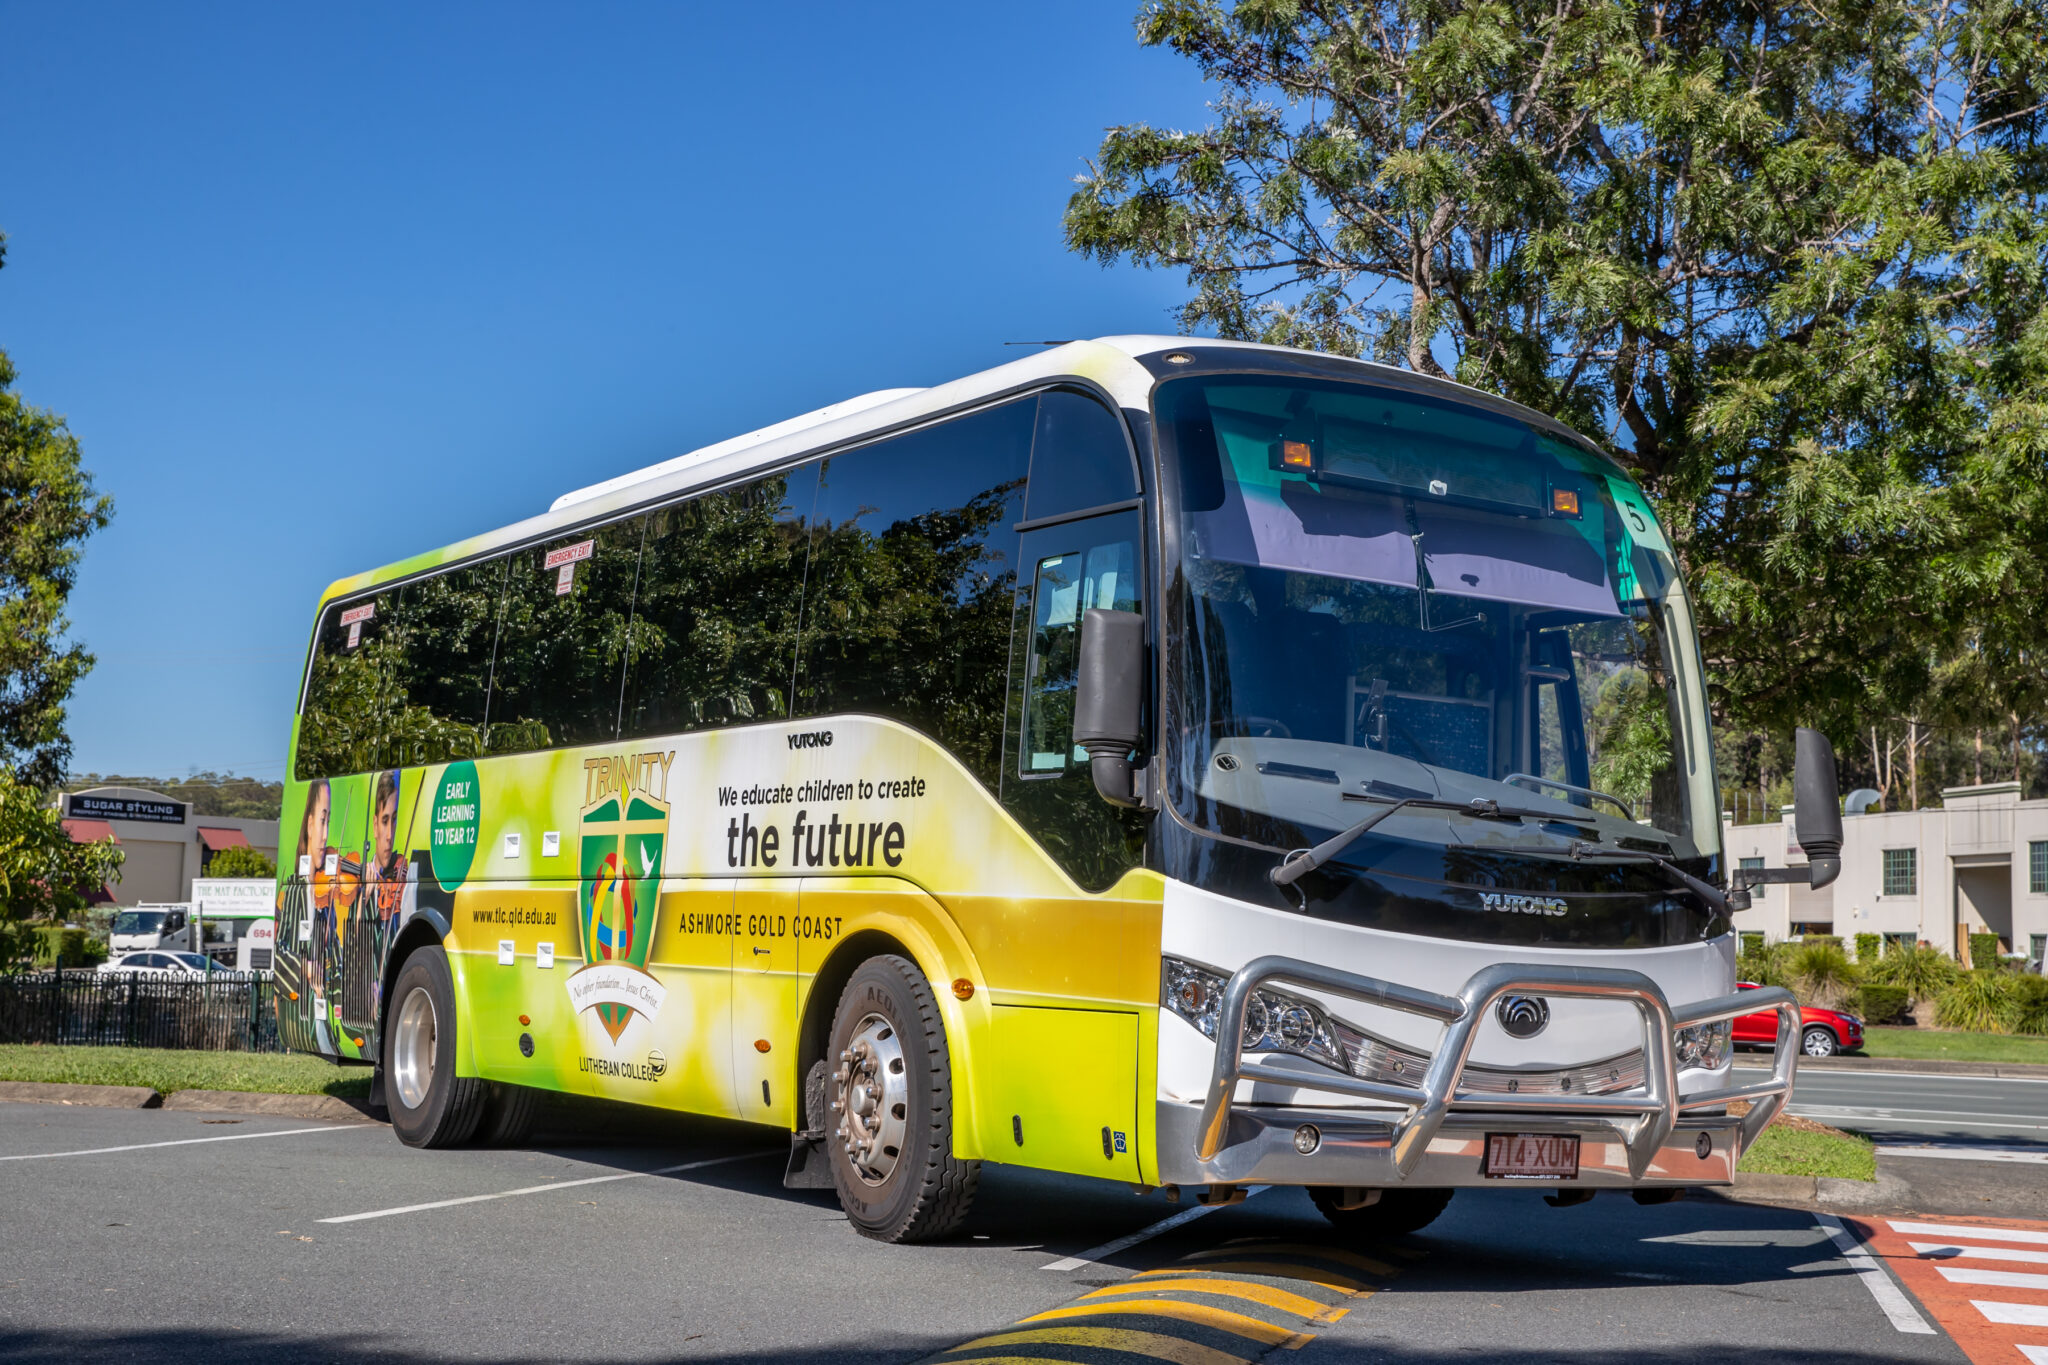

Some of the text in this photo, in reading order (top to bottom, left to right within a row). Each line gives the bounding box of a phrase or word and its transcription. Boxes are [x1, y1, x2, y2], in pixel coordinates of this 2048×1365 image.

[1624, 500, 1646, 533] 5
[547, 543, 590, 566] EMERGENCY EXIT
[787, 730, 834, 750] YUTONG
[584, 750, 676, 807] TRINITY
[445, 781, 471, 800] EARLY
[718, 775, 925, 807] We educate children to create
[83, 799, 174, 814] SUGAR STYLING
[437, 803, 475, 823] LEARNING
[434, 826, 475, 846] TO YEAR 12
[727, 809, 905, 868] the future
[197, 886, 274, 897] THE MAT FACTORY
[1477, 892, 1568, 917] YUTONG
[473, 906, 557, 929] www.tlc.qld.edu.au
[679, 912, 842, 940] ASHMORE GOLD COAST
[253, 929, 272, 938] 694
[578, 1055, 658, 1082] LUTHERAN COLLEGE
